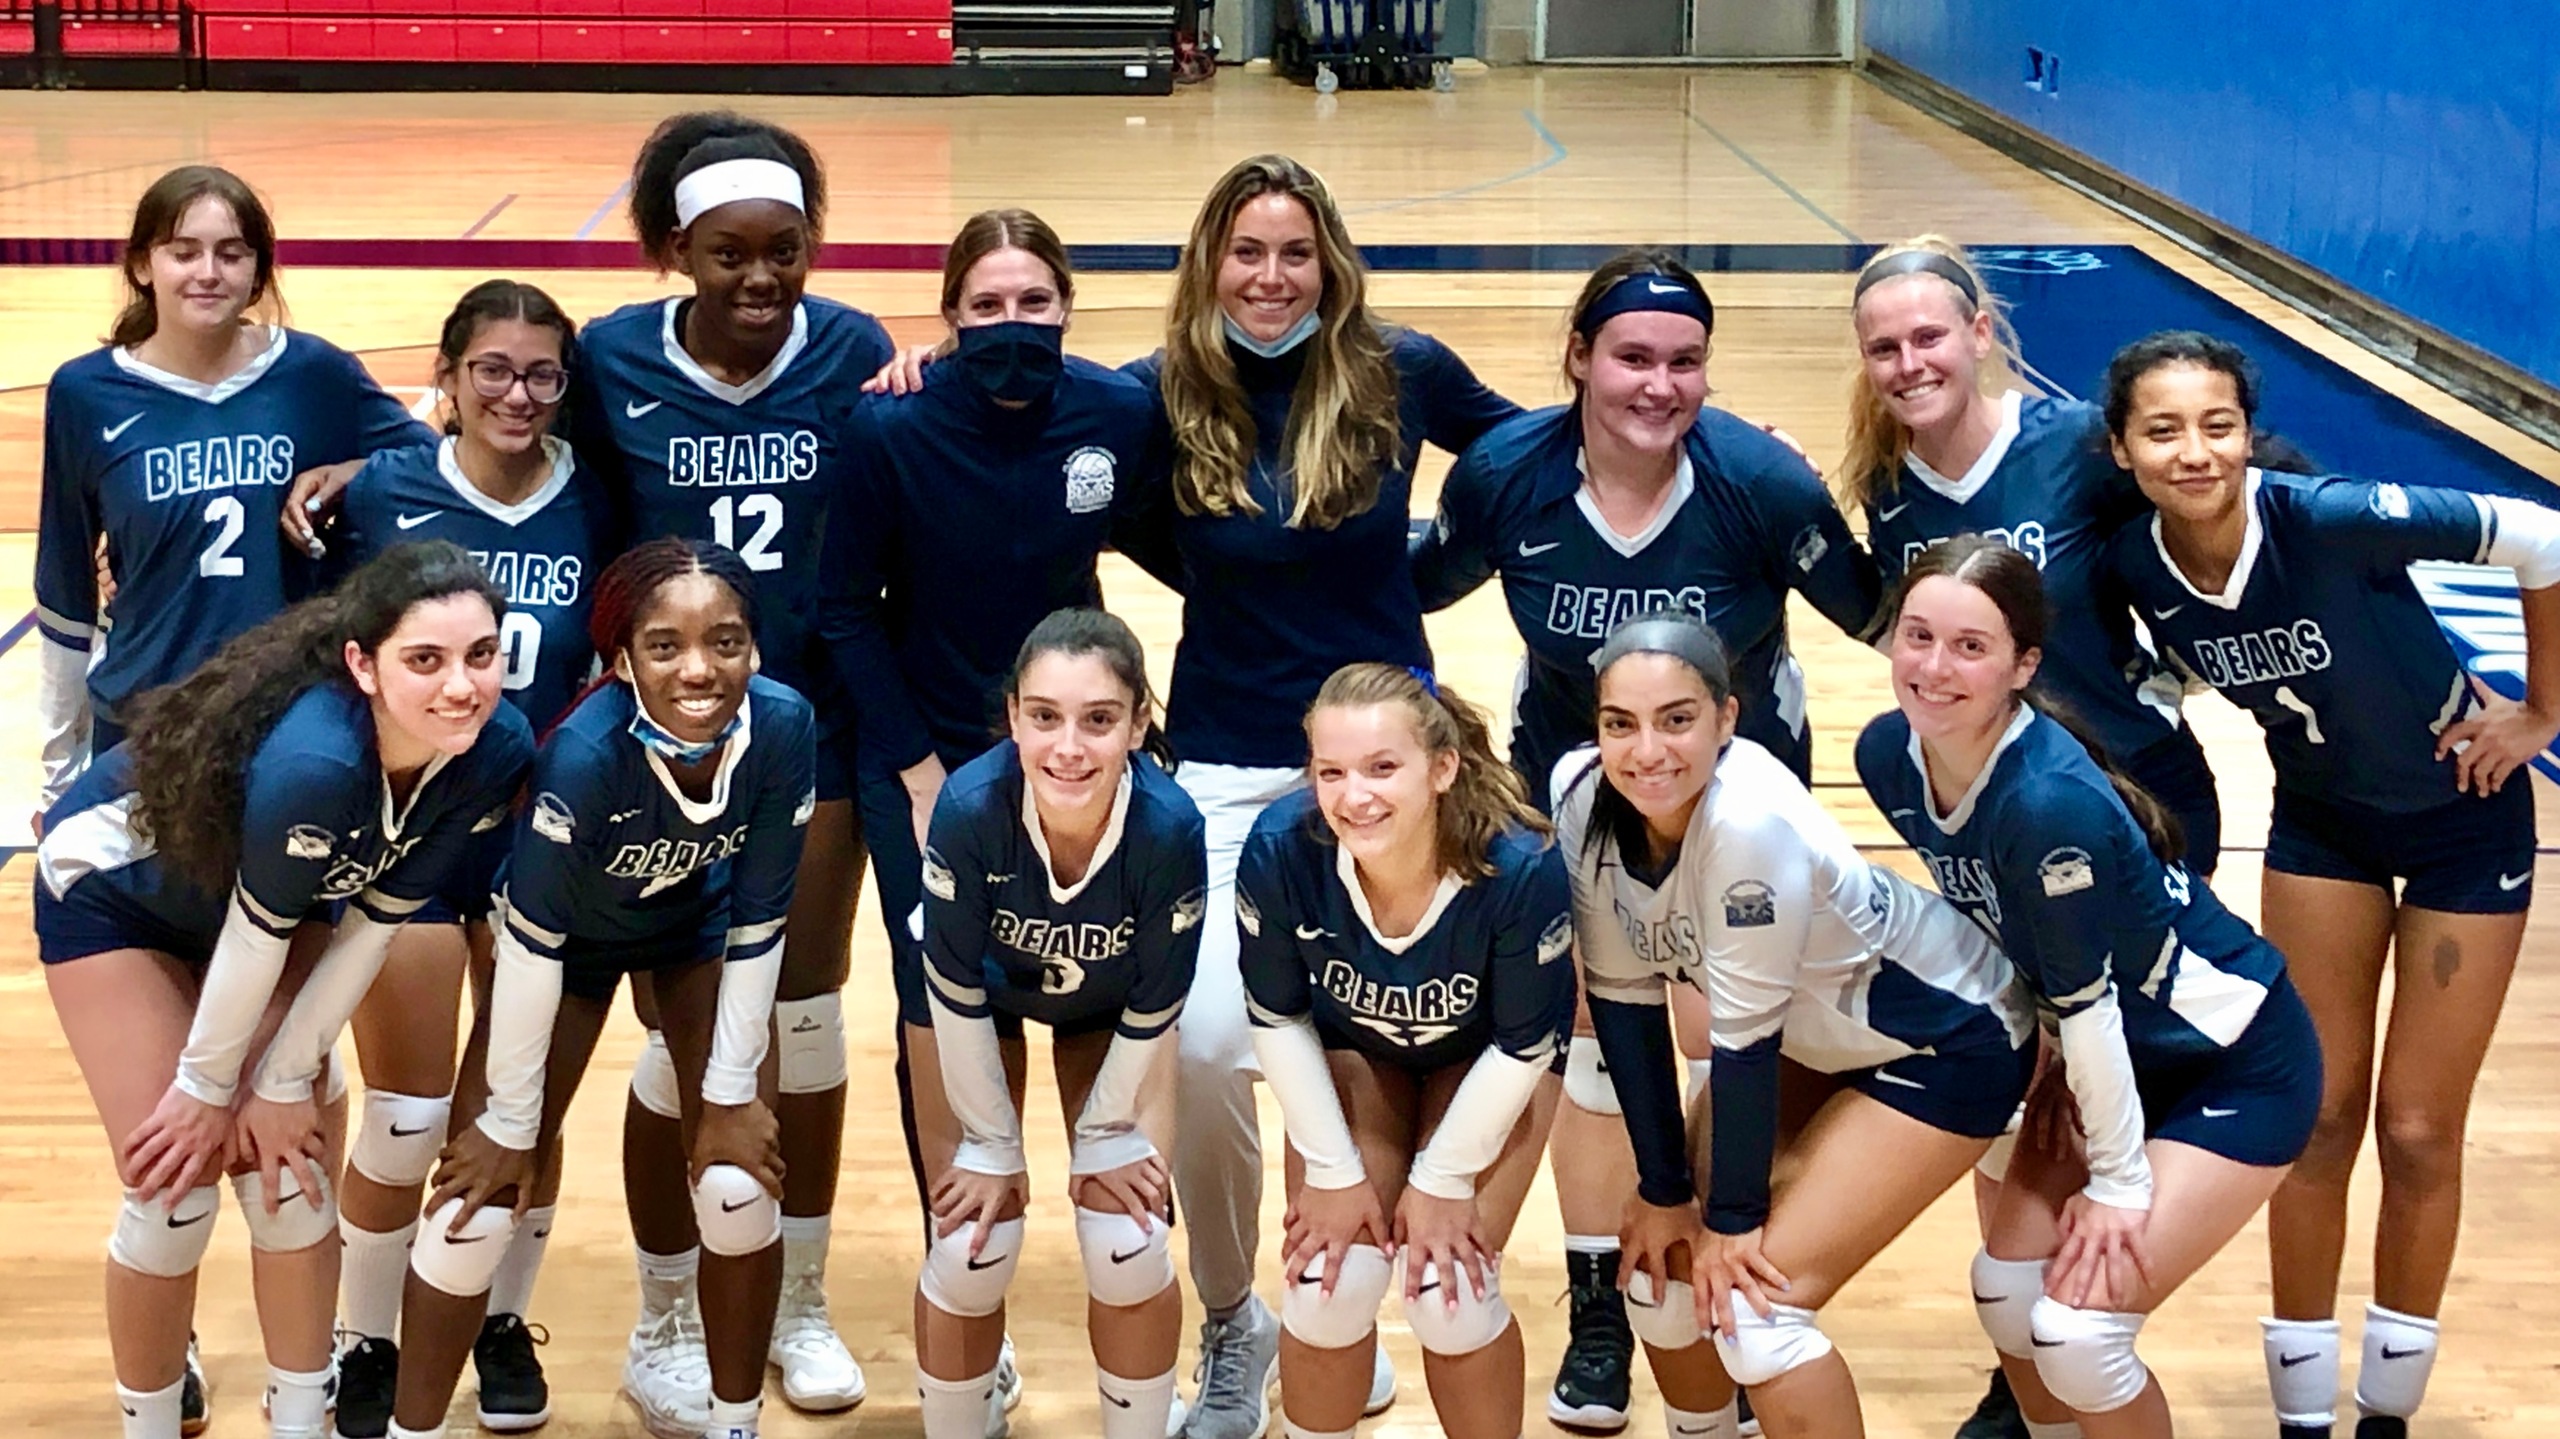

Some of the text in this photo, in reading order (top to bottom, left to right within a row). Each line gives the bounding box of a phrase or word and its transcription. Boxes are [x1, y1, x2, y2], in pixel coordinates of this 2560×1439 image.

[145, 434, 294, 502] BEARS
[669, 430, 818, 487] BEARS
[200, 496, 244, 577] 2
[709, 494, 783, 571] 12
[467, 551, 582, 606] ARS
[2193, 619, 2332, 687] BEARS
[2275, 686, 2325, 743] 1
[990, 908, 1135, 960] BEARS
[1613, 898, 1702, 967] EAS
[1322, 959, 1479, 1022] BEARS
